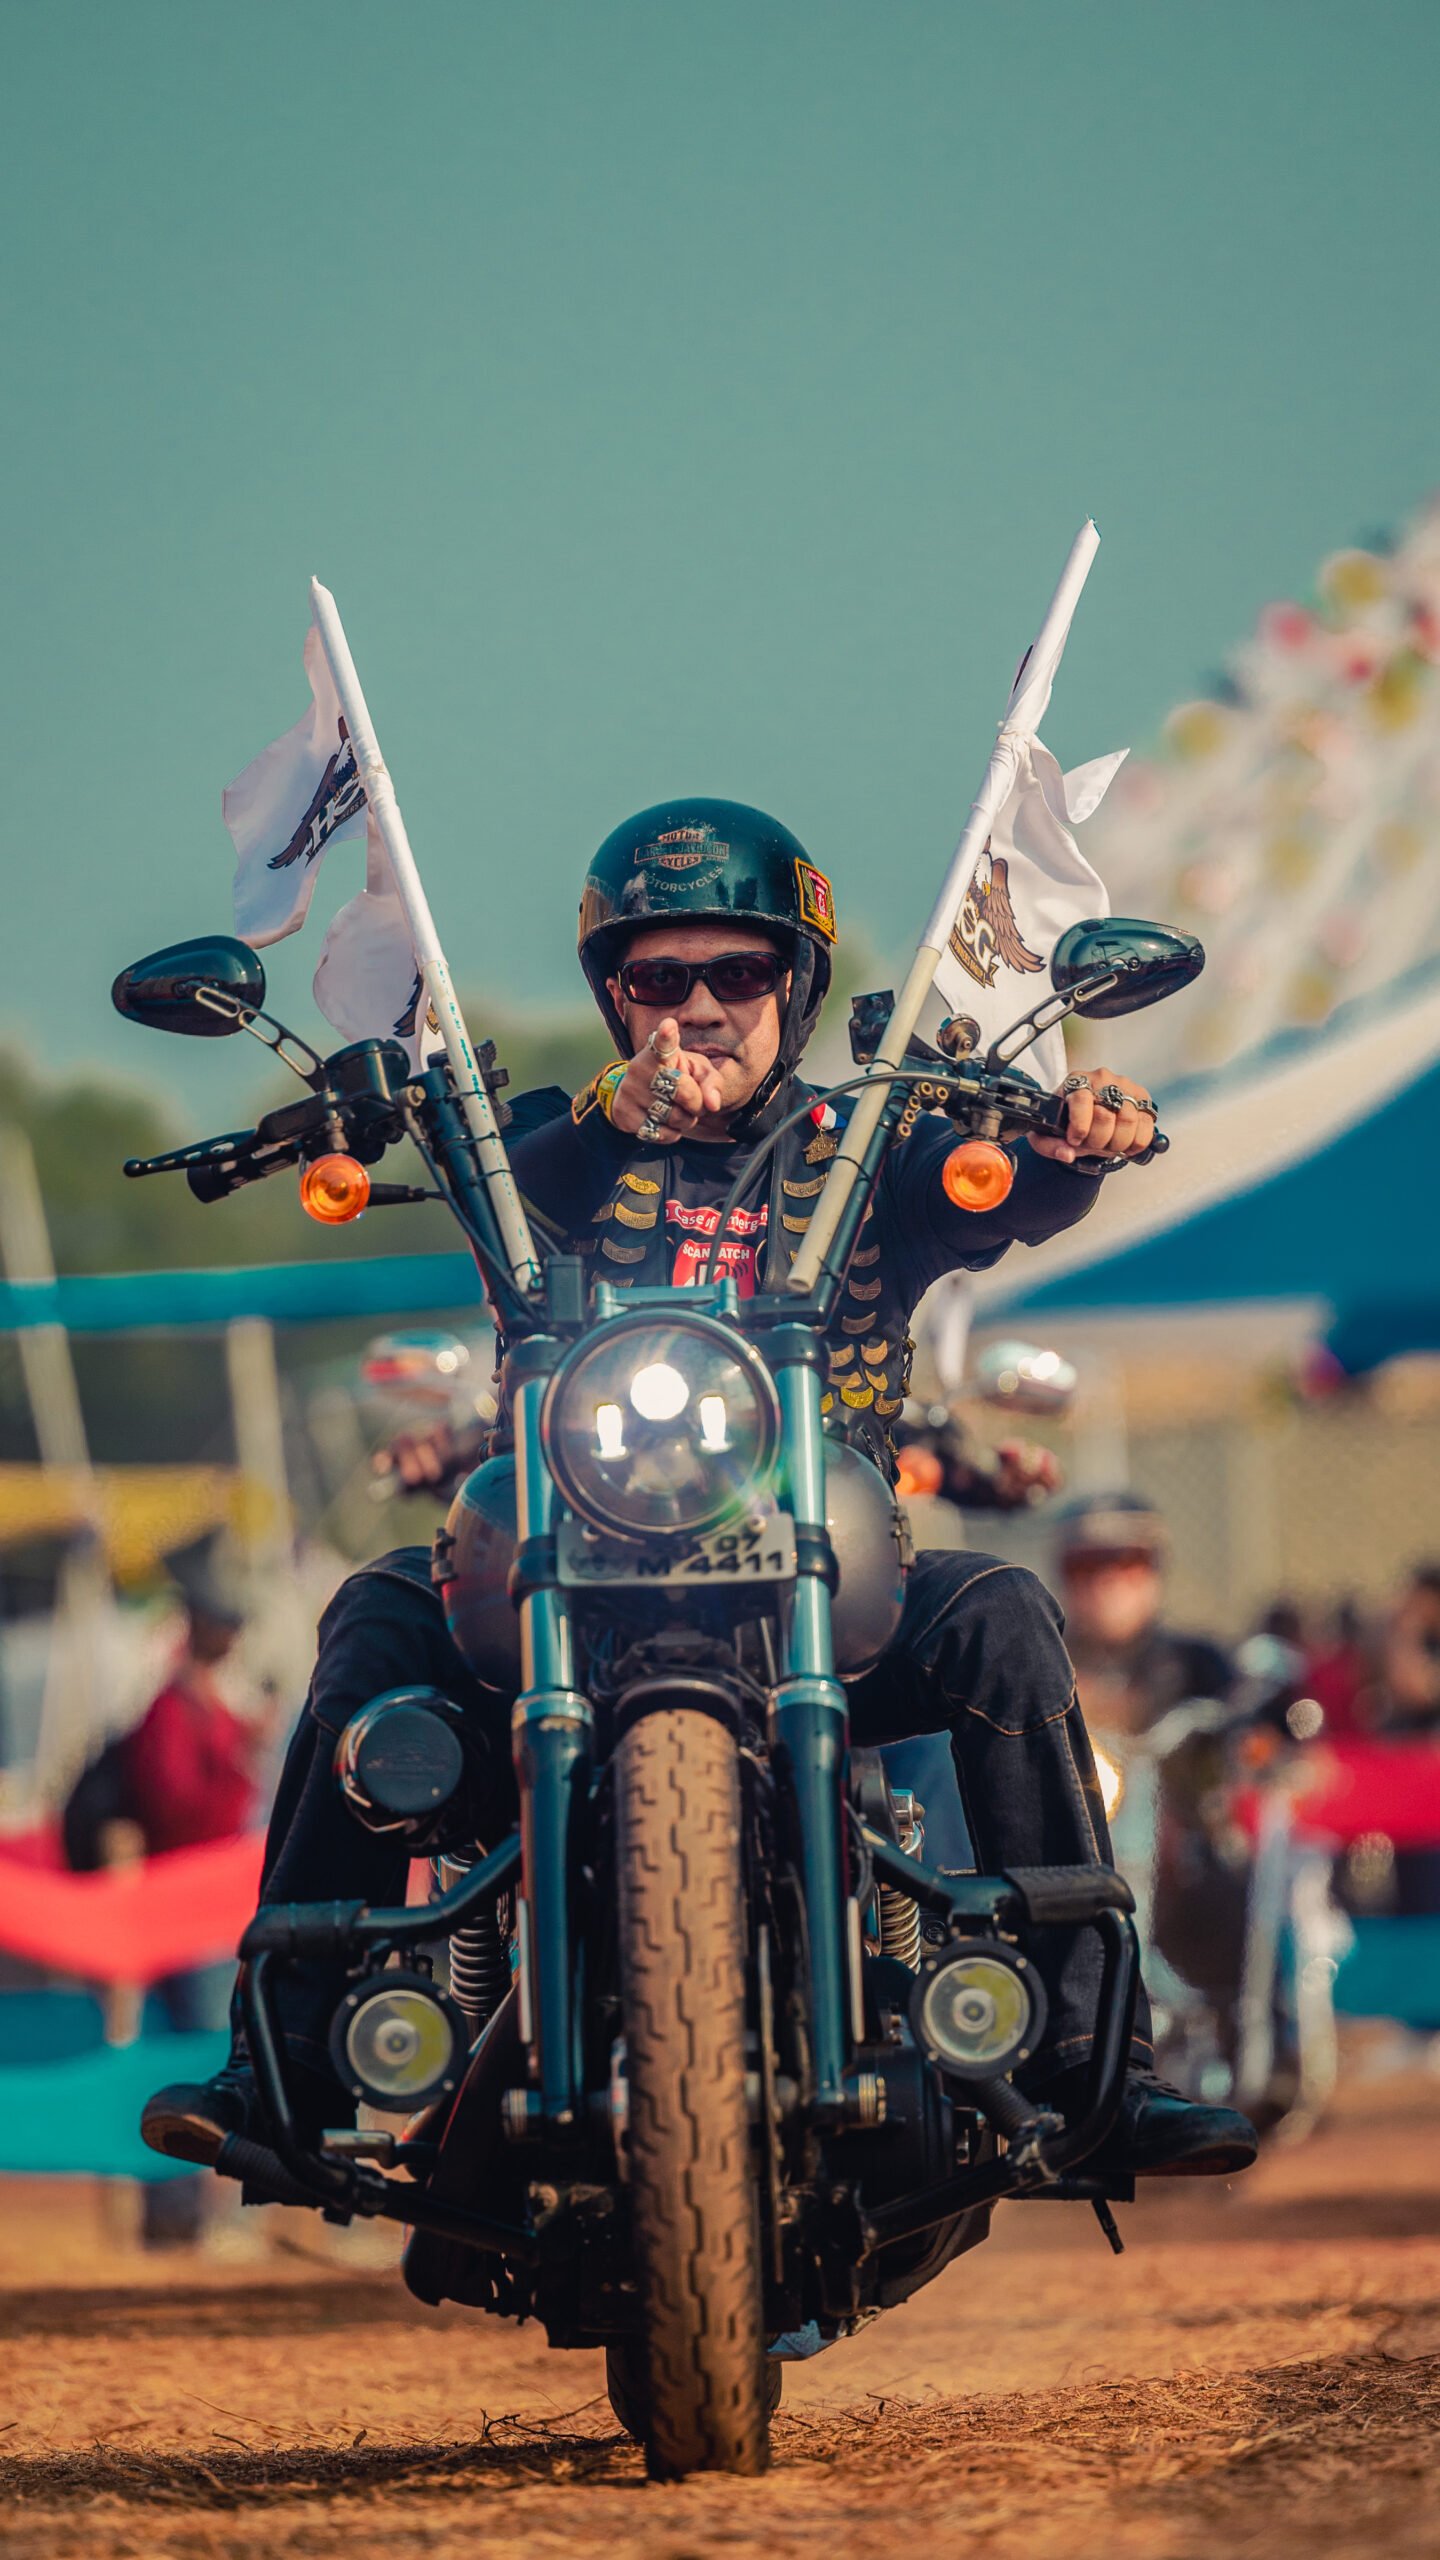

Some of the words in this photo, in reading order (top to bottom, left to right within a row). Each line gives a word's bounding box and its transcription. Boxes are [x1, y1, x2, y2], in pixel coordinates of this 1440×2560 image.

[662, 830, 700, 842] MOTOR
[661, 856, 699, 868] CYCLES
[675, 1206, 704, 1225] Case
[705, 1215, 717, 1229] of
[682, 1244, 710, 1258] SCAN
[718, 1247, 750, 1260] ATCH
[637, 1556, 670, 1576] M
[685, 1551, 782, 1574] 4411
